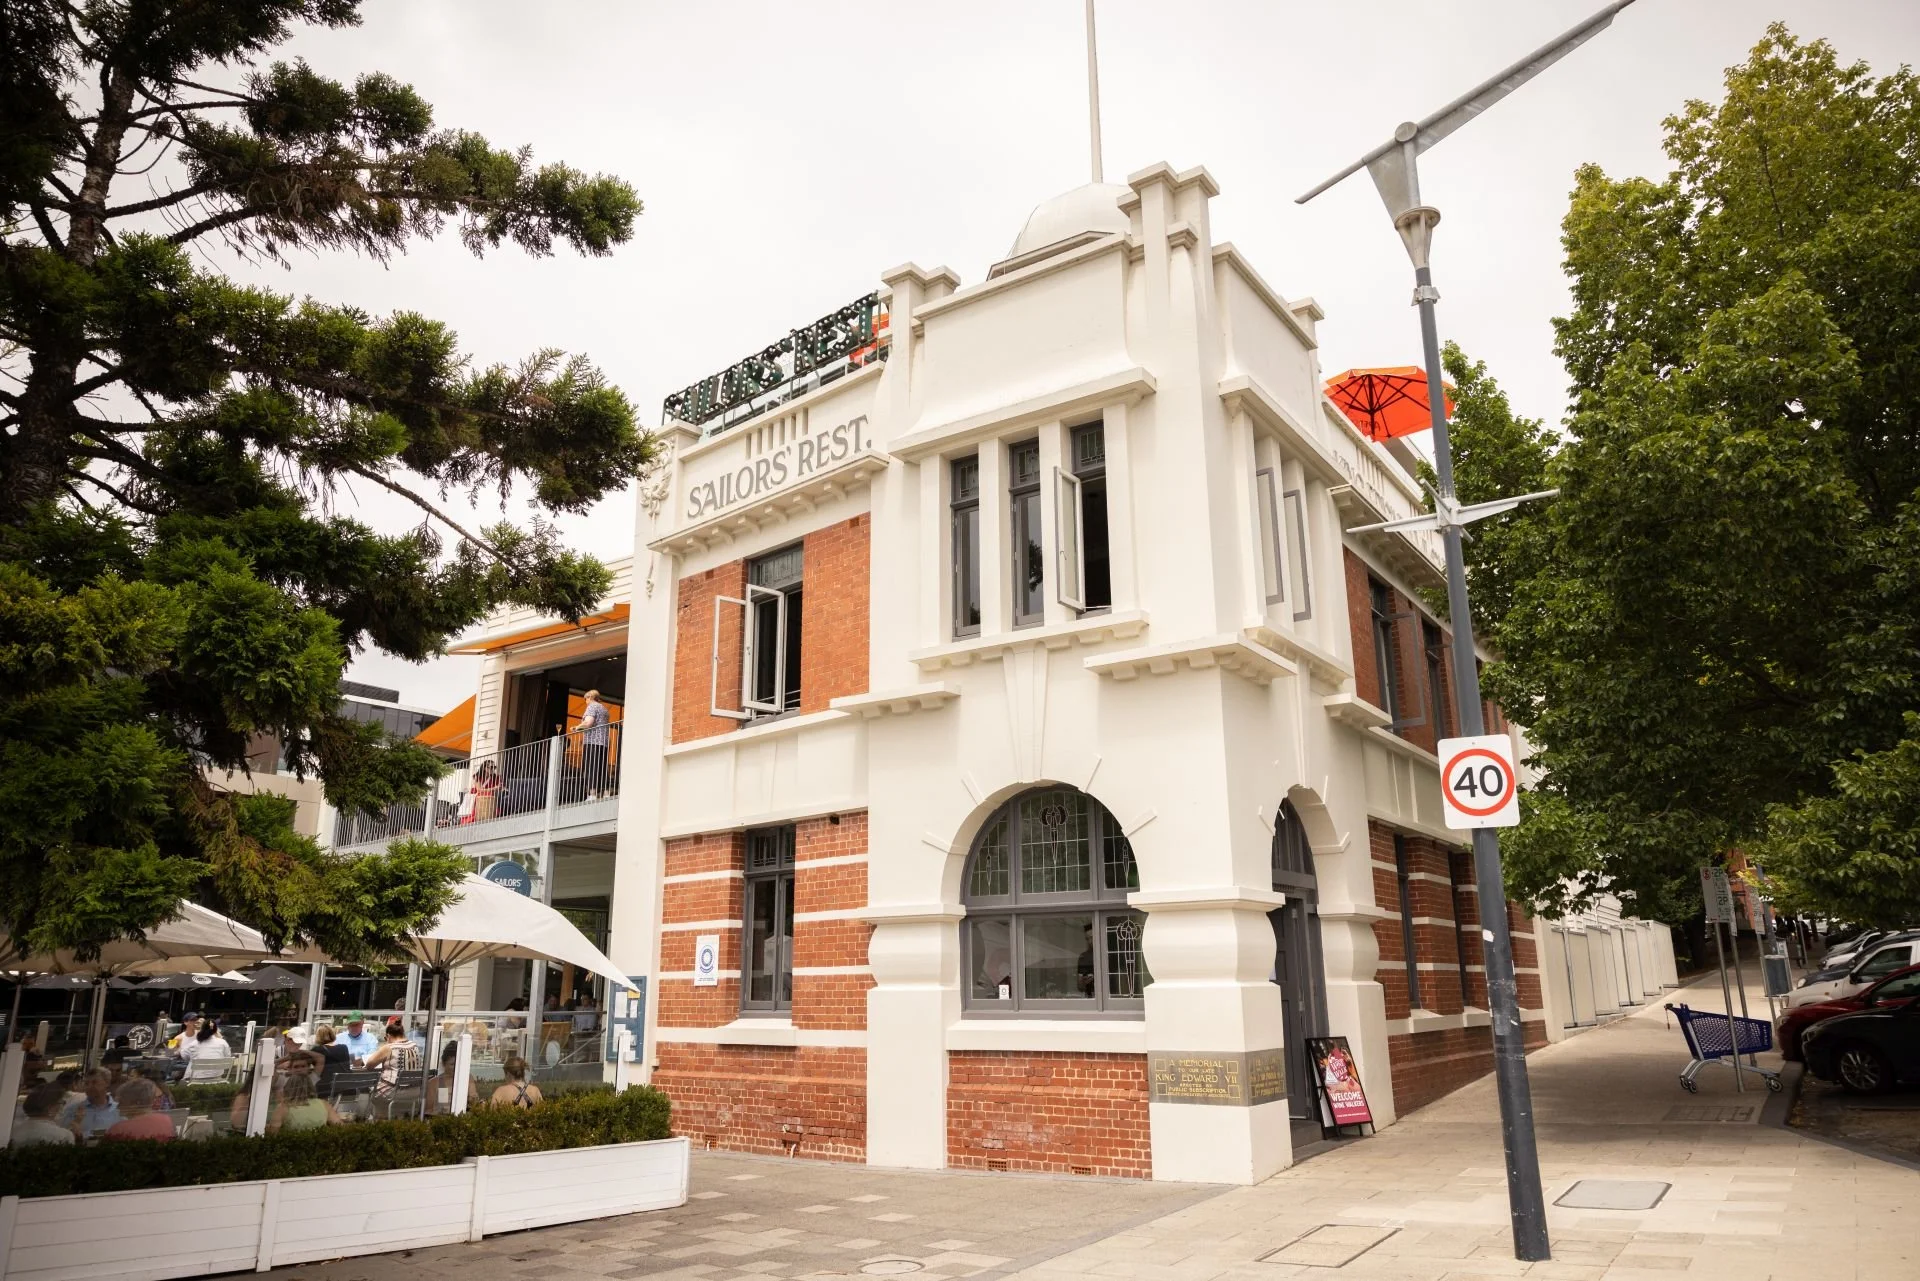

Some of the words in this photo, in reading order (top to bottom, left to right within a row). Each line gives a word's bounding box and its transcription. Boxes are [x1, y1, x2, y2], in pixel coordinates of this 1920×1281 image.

[794, 291, 879, 375] REST
[688, 446, 792, 519] SAILORS'
[797, 414, 872, 477] REST.
[1453, 764, 1504, 798] 40
[1179, 1059, 1224, 1068] MEMORIAL
[1155, 1073, 1176, 1082] KING
[1181, 1074, 1219, 1083] EDWARD
[1224, 1075, 1237, 1084] VII
[1330, 1091, 1362, 1102] WELCOME
